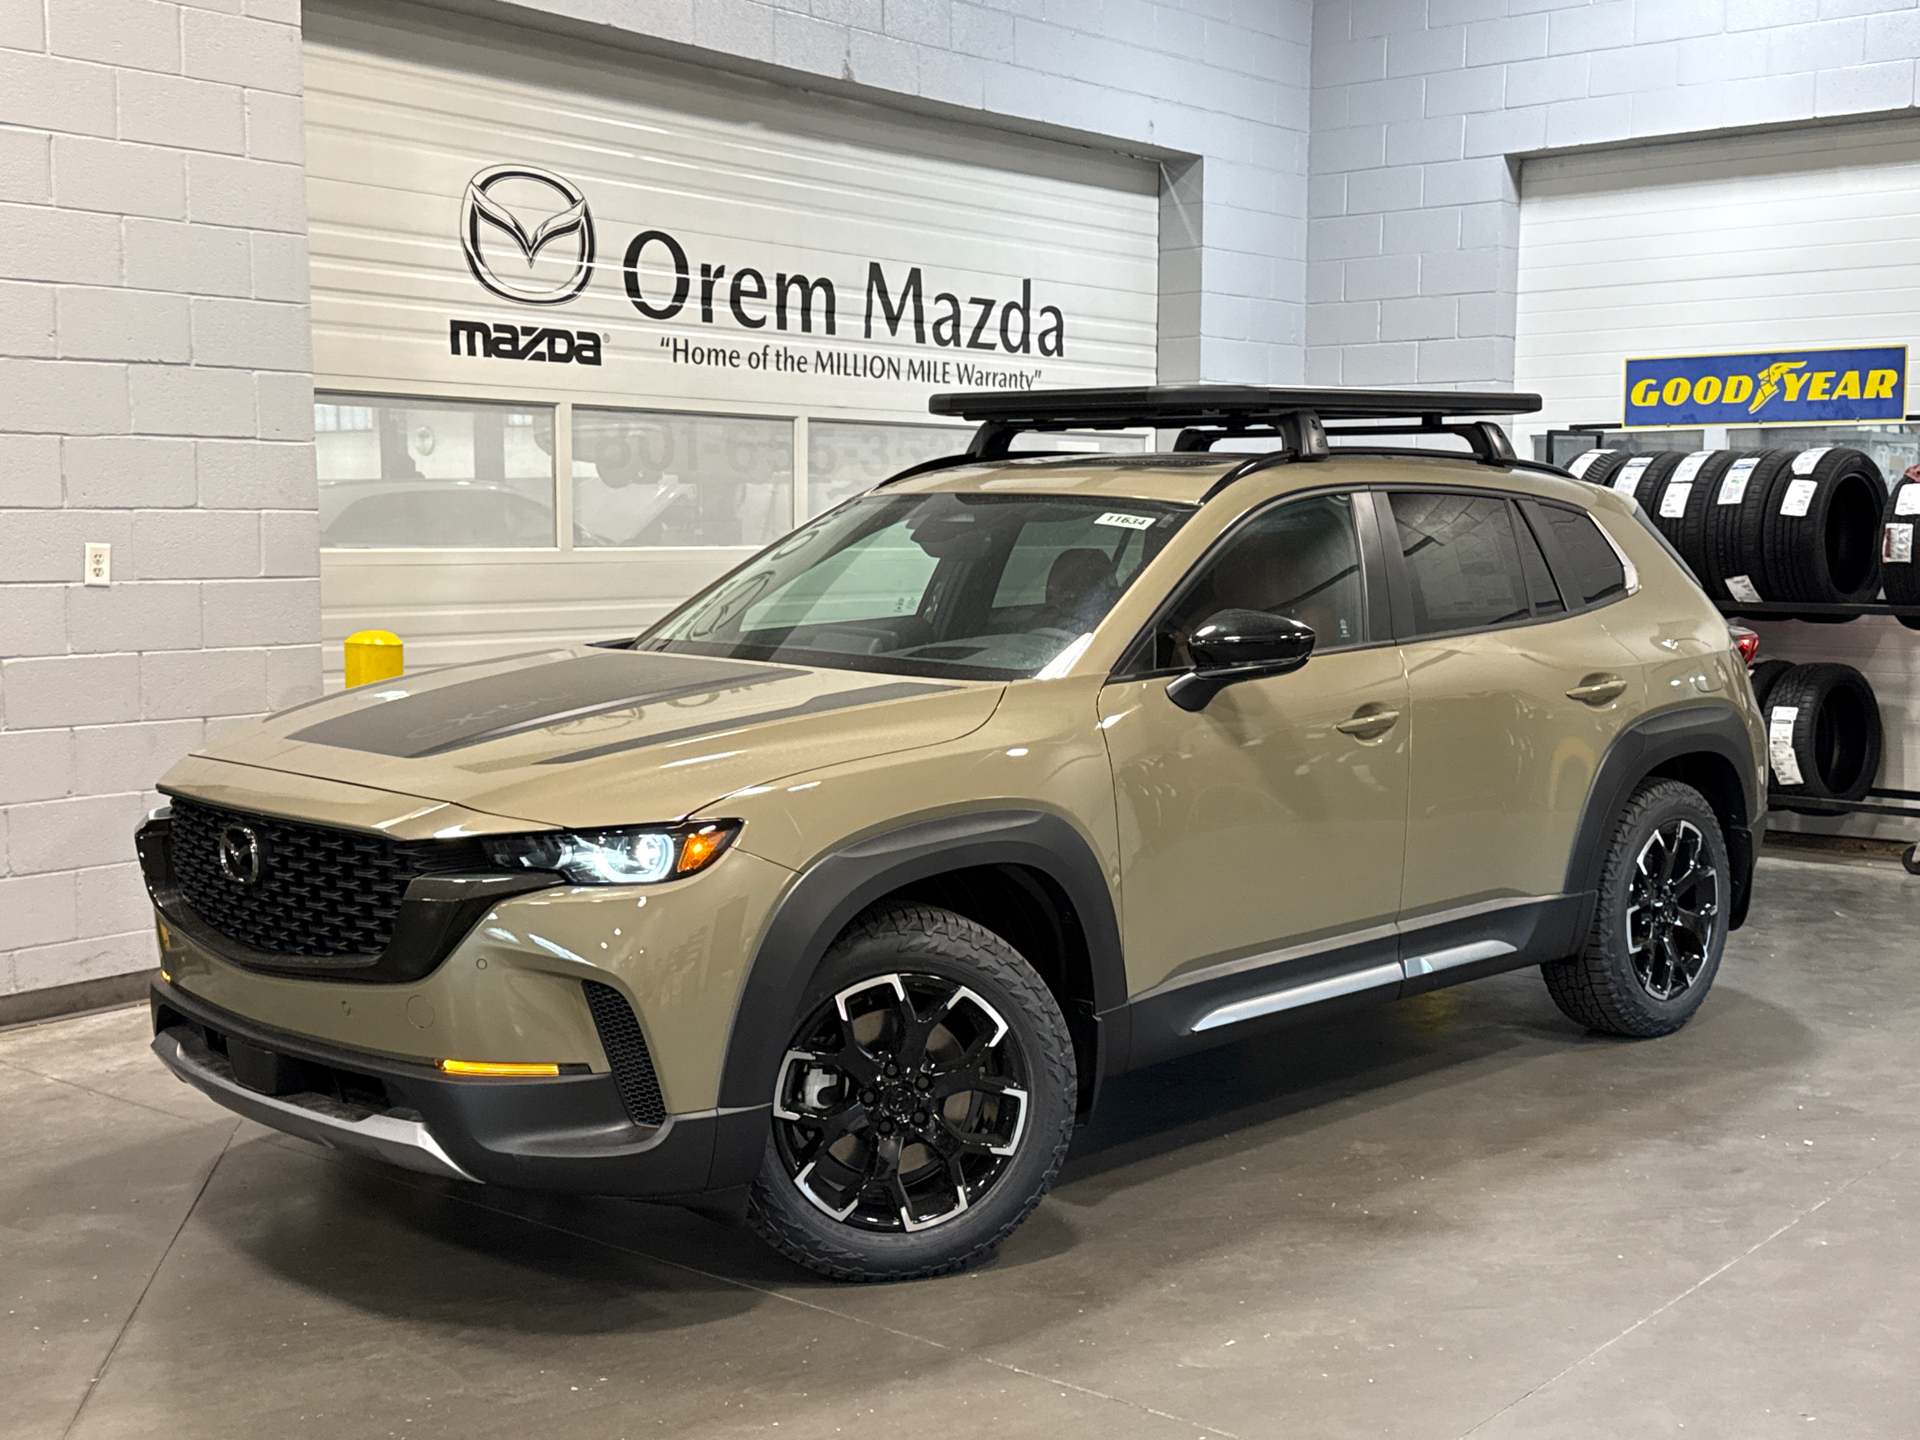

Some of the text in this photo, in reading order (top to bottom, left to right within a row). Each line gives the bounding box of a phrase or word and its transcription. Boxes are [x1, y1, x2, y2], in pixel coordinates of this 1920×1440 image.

[623, 230, 1064, 357] Orem Mazda
[748, 345, 770, 370] of
[775, 347, 808, 373] the
[814, 350, 900, 380] MILLION
[907, 359, 950, 384] MILE
[1107, 515, 1147, 525] 11634
